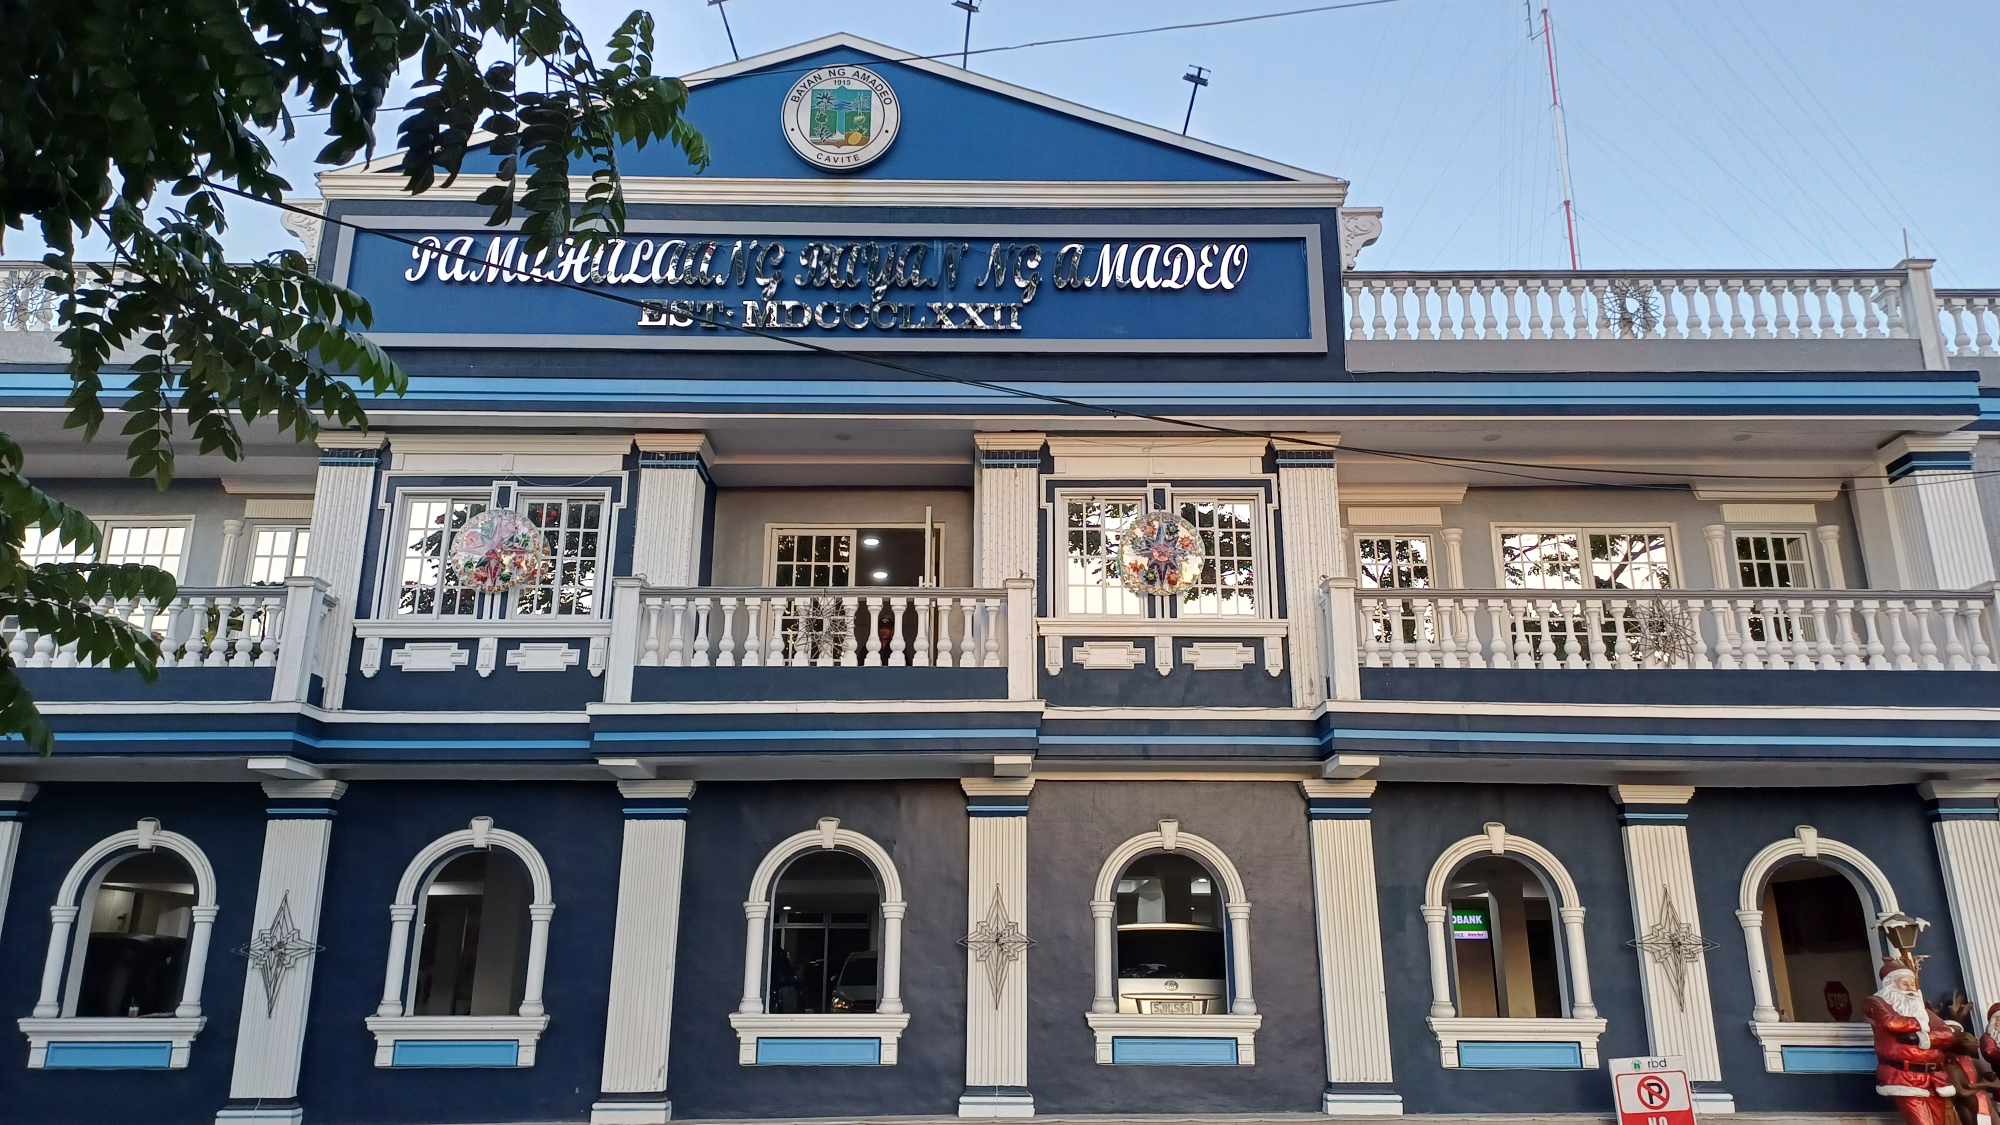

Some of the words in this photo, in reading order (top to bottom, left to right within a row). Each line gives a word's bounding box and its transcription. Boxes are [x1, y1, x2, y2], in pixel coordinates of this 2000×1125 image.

[791, 73, 822, 103] BAYAN
[828, 68, 846, 78] NG
[852, 71, 892, 105] AMADEO
[816, 152, 860, 164] CAVITE
[1053, 242, 1249, 290] AMADEO
